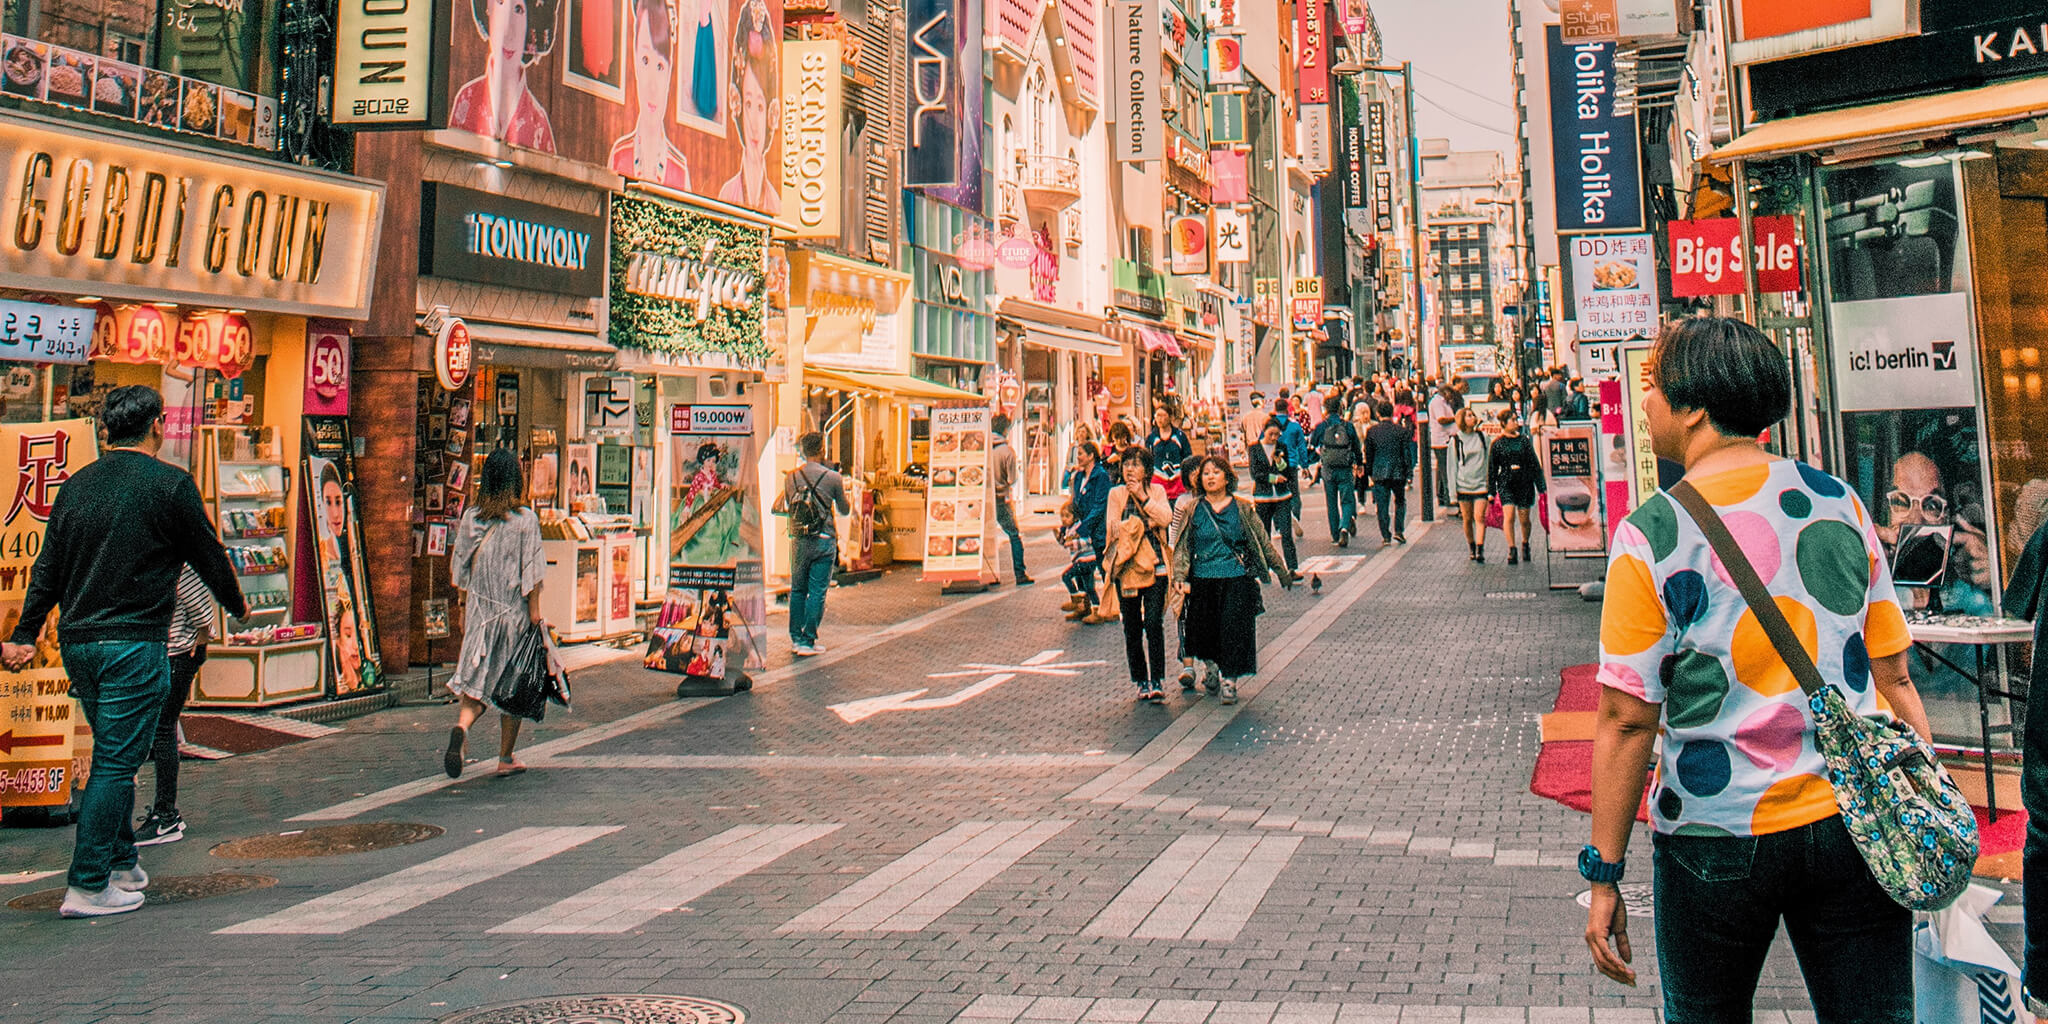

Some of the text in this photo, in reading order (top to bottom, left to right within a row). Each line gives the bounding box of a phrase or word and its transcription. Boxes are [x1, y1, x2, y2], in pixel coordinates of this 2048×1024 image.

[166, 7, 198, 33] うどん
[1567, 22, 1613, 36] mall
[1303, 49, 1316, 68] 2
[913, 10, 947, 148] VDL
[1128, 4, 1145, 155] Nature Collection
[1310, 88, 1324, 99] 3F
[353, 98, 409, 116] 곱디고운
[801, 53, 826, 228] SKINFOOD
[1349, 127, 1360, 206] HOLLYS COFFEE
[1580, 131, 1612, 224] Holika
[14, 151, 329, 285] GOBDI GOUN
[474, 211, 591, 271] TONYMOLY
[1219, 222, 1242, 250] 光
[1579, 240, 1608, 256] DD
[1676, 237, 1723, 282] Big
[937, 263, 969, 304] VDL
[1296, 280, 1318, 294] BIG
[1295, 300, 1319, 314] MART
[1582, 293, 1651, 309] 炸鸡和啤酒
[57, 318, 81, 336] 우동
[1588, 310, 1647, 324] 可以 打包
[130, 318, 164, 359] 50
[178, 322, 210, 361] 50
[220, 325, 250, 365] 50
[1582, 328, 1622, 338] CHICKEN
[315, 347, 342, 385] 50
[1850, 347, 1929, 371] ic! berlin
[4, 430, 73, 527] 足
[12, 681, 33, 698] 마사지
[10, 705, 32, 722] 마사지
[48, 767, 64, 792] 3F
